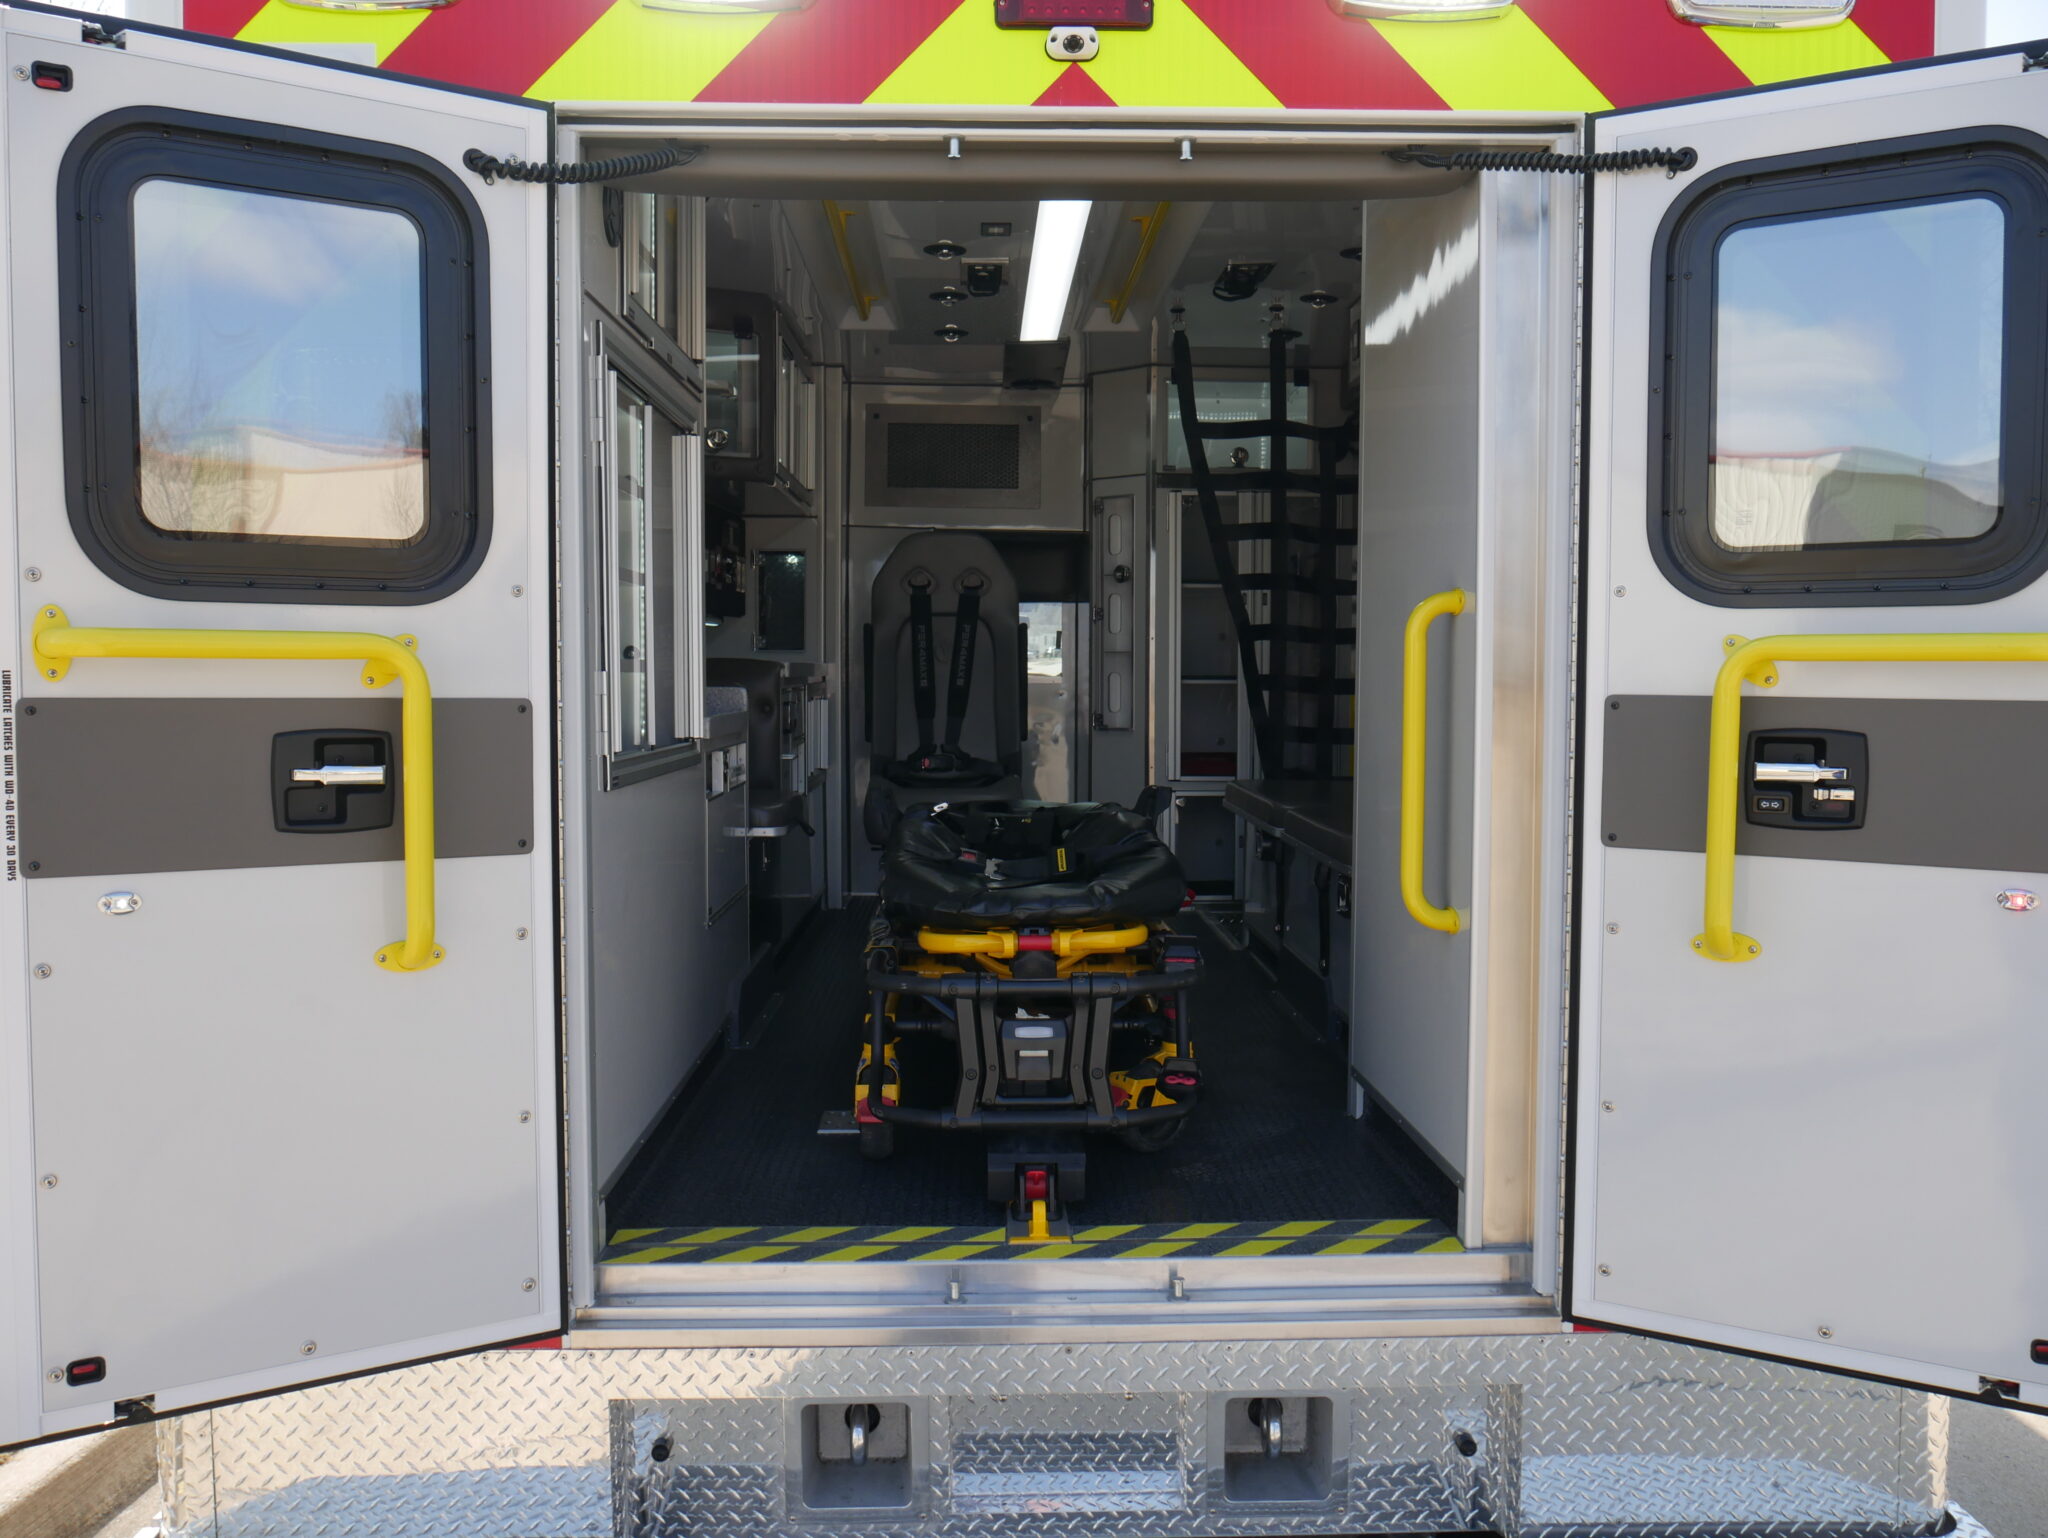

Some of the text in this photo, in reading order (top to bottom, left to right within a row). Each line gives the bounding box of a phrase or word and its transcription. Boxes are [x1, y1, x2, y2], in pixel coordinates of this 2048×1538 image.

[2, 669, 16, 882] LUBRICATE LATCHES WITH WD-40 EVERY 30 DAYS
